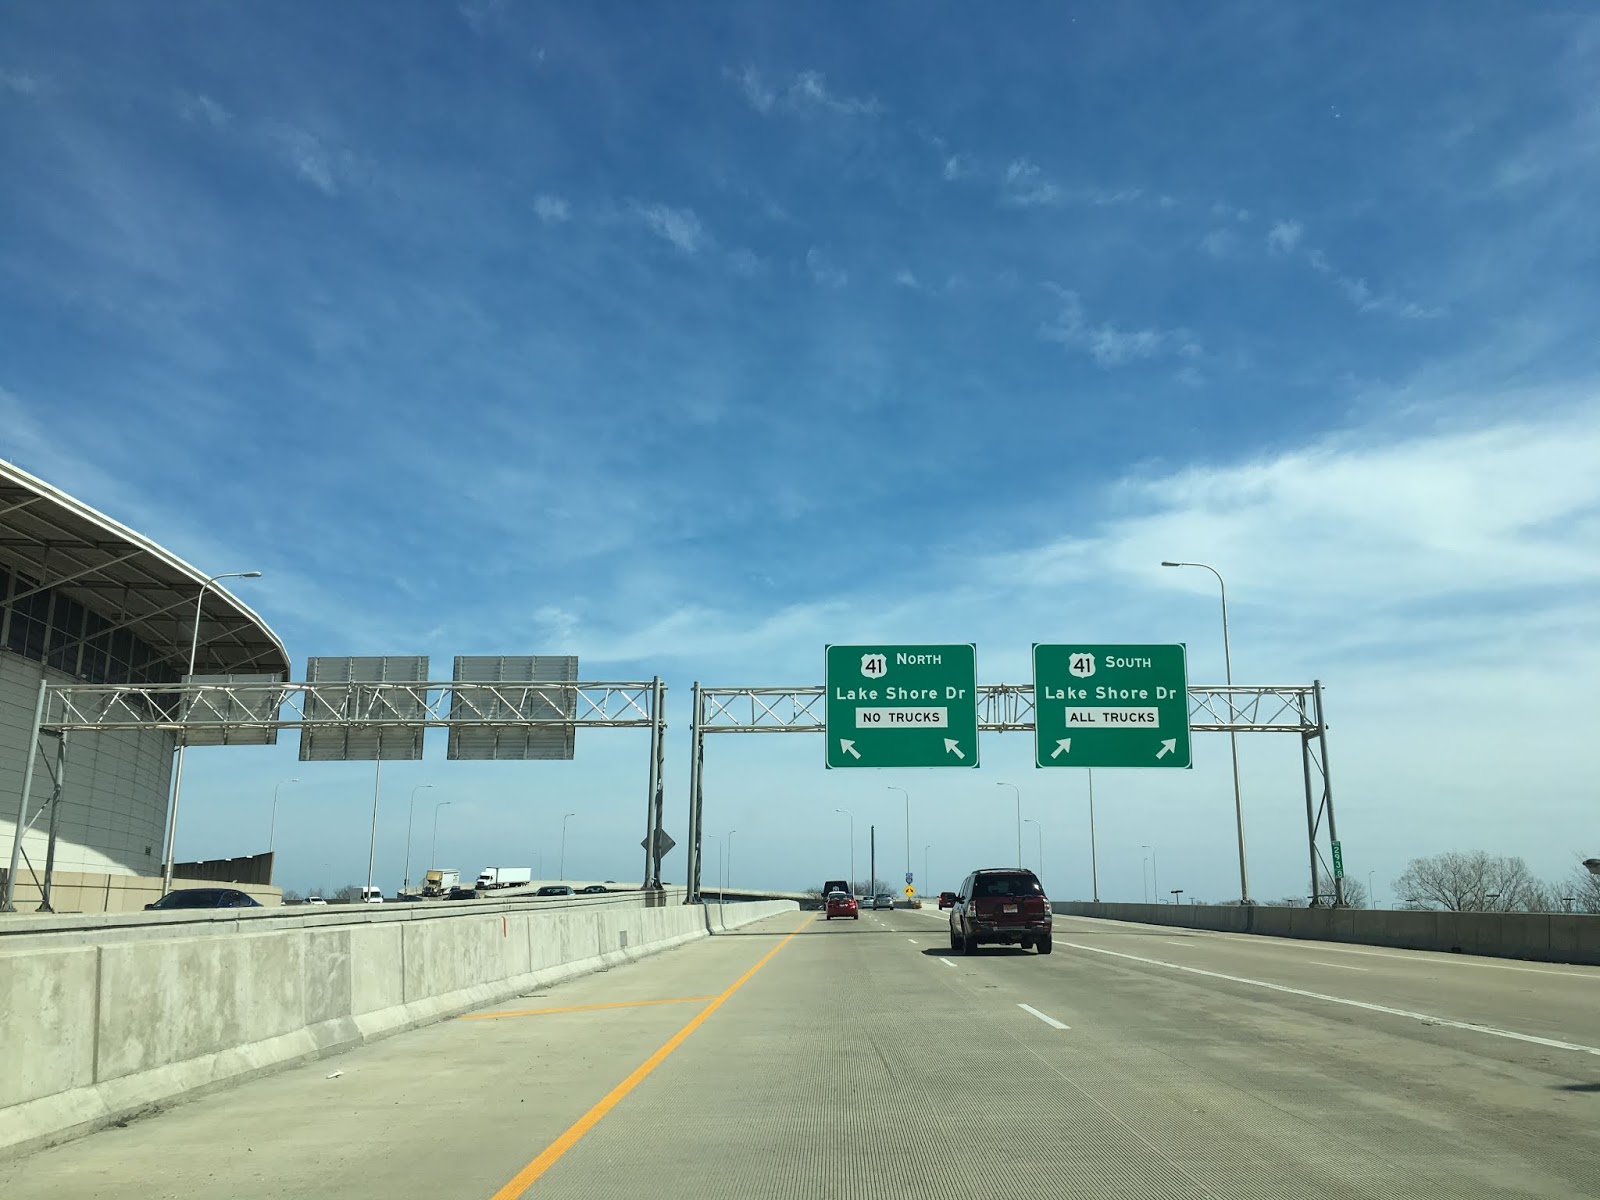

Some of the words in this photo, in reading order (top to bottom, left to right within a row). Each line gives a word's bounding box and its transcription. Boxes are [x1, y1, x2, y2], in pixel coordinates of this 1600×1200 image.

[864, 658, 882, 674] 41
[896, 652, 942, 665] NORTH
[1073, 657, 1091, 673] 41
[1105, 655, 1152, 668] SOUTH
[836, 686, 878, 700] Lake
[886, 686, 938, 700] Shore
[946, 686, 966, 700] Dr
[1045, 686, 1088, 700] Lake
[1095, 686, 1148, 700] Shore
[1156, 686, 1177, 700] Dr
[863, 711, 881, 723] NO
[888, 711, 940, 723] TRUCKS
[1069, 711, 1096, 723] ALL
[1102, 711, 1156, 723] TRUCKS
